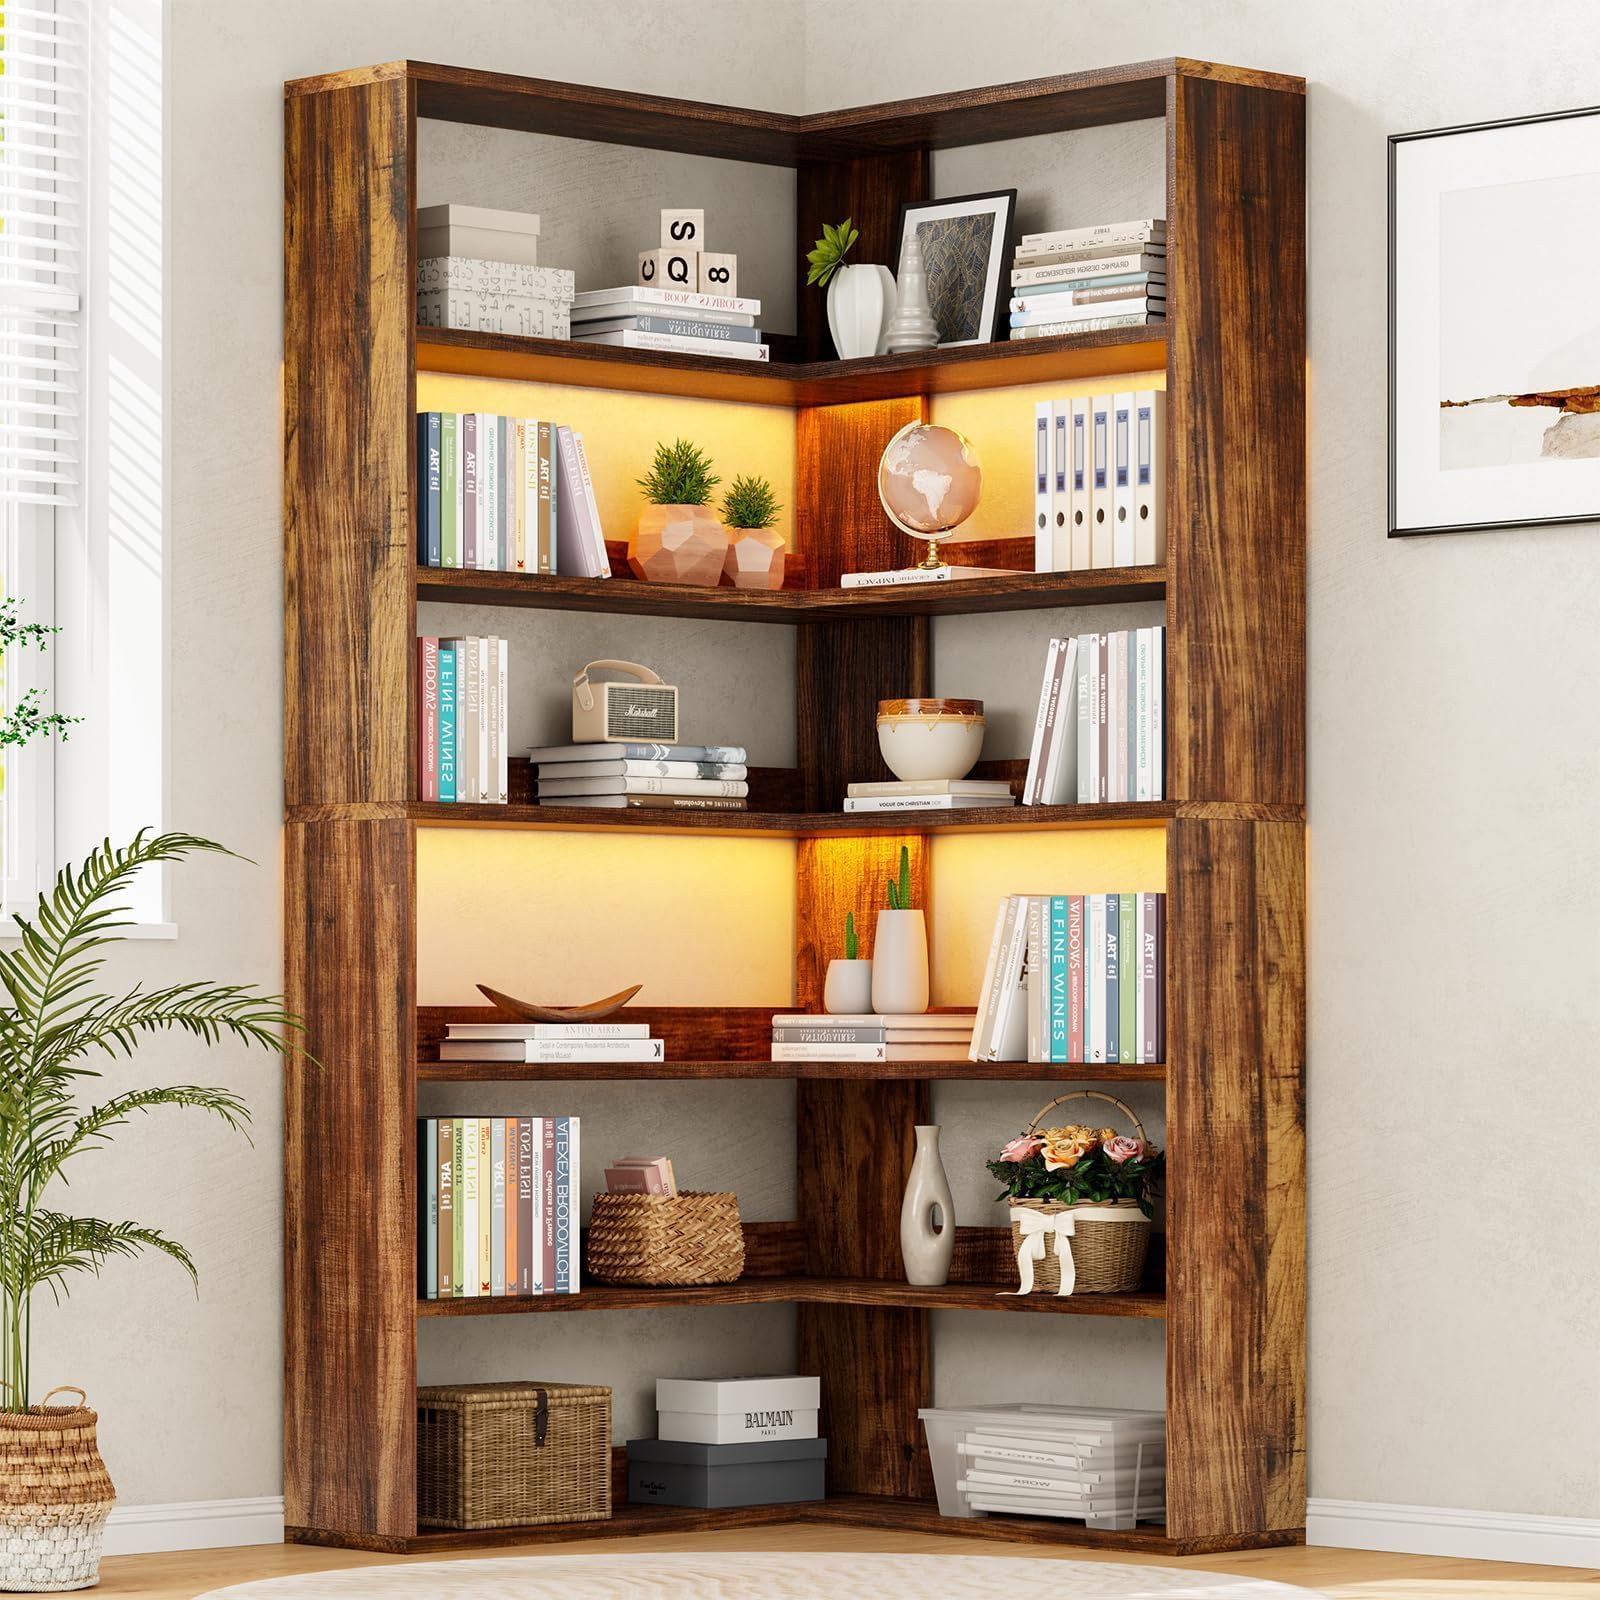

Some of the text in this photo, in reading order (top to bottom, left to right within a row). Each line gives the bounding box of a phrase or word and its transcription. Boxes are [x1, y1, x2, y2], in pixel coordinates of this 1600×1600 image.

[670, 220, 696, 241] S
[668, 256, 689, 284] Q
[708, 267, 730, 284] 8
[430, 448, 439, 473] ART
[466, 451, 476, 476] ART
[528, 424, 536, 490] LOST FISH
[562, 430, 583, 497] LOST FISH
[576, 440, 591, 487] MAKING IT
[540, 458, 550, 482] ART
[625, 704, 658, 718] Marshall
[674, 799, 705, 807] Revolution
[1030, 902, 1040, 973] LOST FISH
[1070, 900, 1081, 970] WINDOWS
[1107, 934, 1117, 960] ART
[1145, 933, 1154, 960] ART
[1054, 920, 1065, 1040] FINE WINES
[564, 1026, 621, 1035] ANTIQUAIRES
[745, 1410, 793, 1429] BALMAIN
